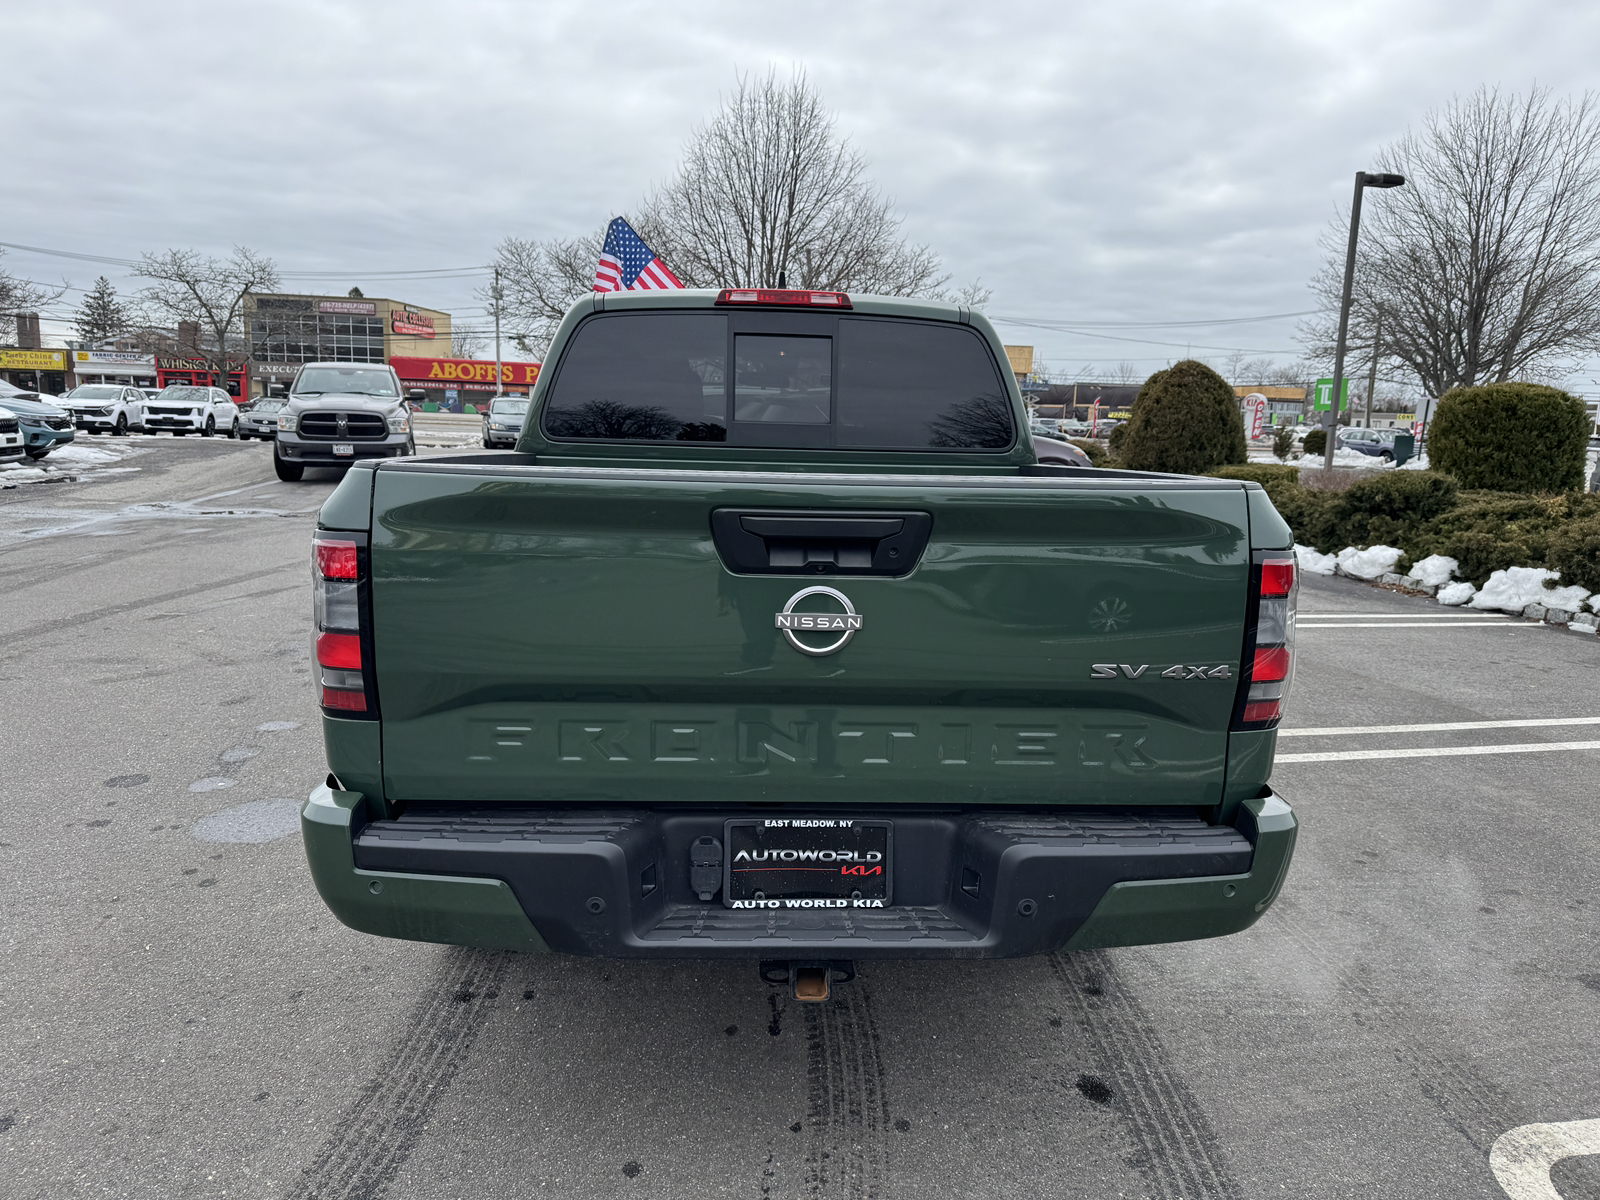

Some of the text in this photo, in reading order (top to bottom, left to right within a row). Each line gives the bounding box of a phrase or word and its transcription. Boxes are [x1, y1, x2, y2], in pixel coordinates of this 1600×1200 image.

[30, 352, 52, 360] China
[1252, 403, 1264, 436] OPEN
[777, 615, 860, 628] NISSAN
[1090, 664, 1232, 680] SV 4x4
[464, 717, 1156, 769] FRONTIER
[764, 820, 790, 828] EAST
[839, 820, 854, 828] NY
[733, 849, 882, 863] AUTOWORLD
[841, 865, 882, 876] KIA
[732, 900, 884, 909] AUTO WORLD KIA
